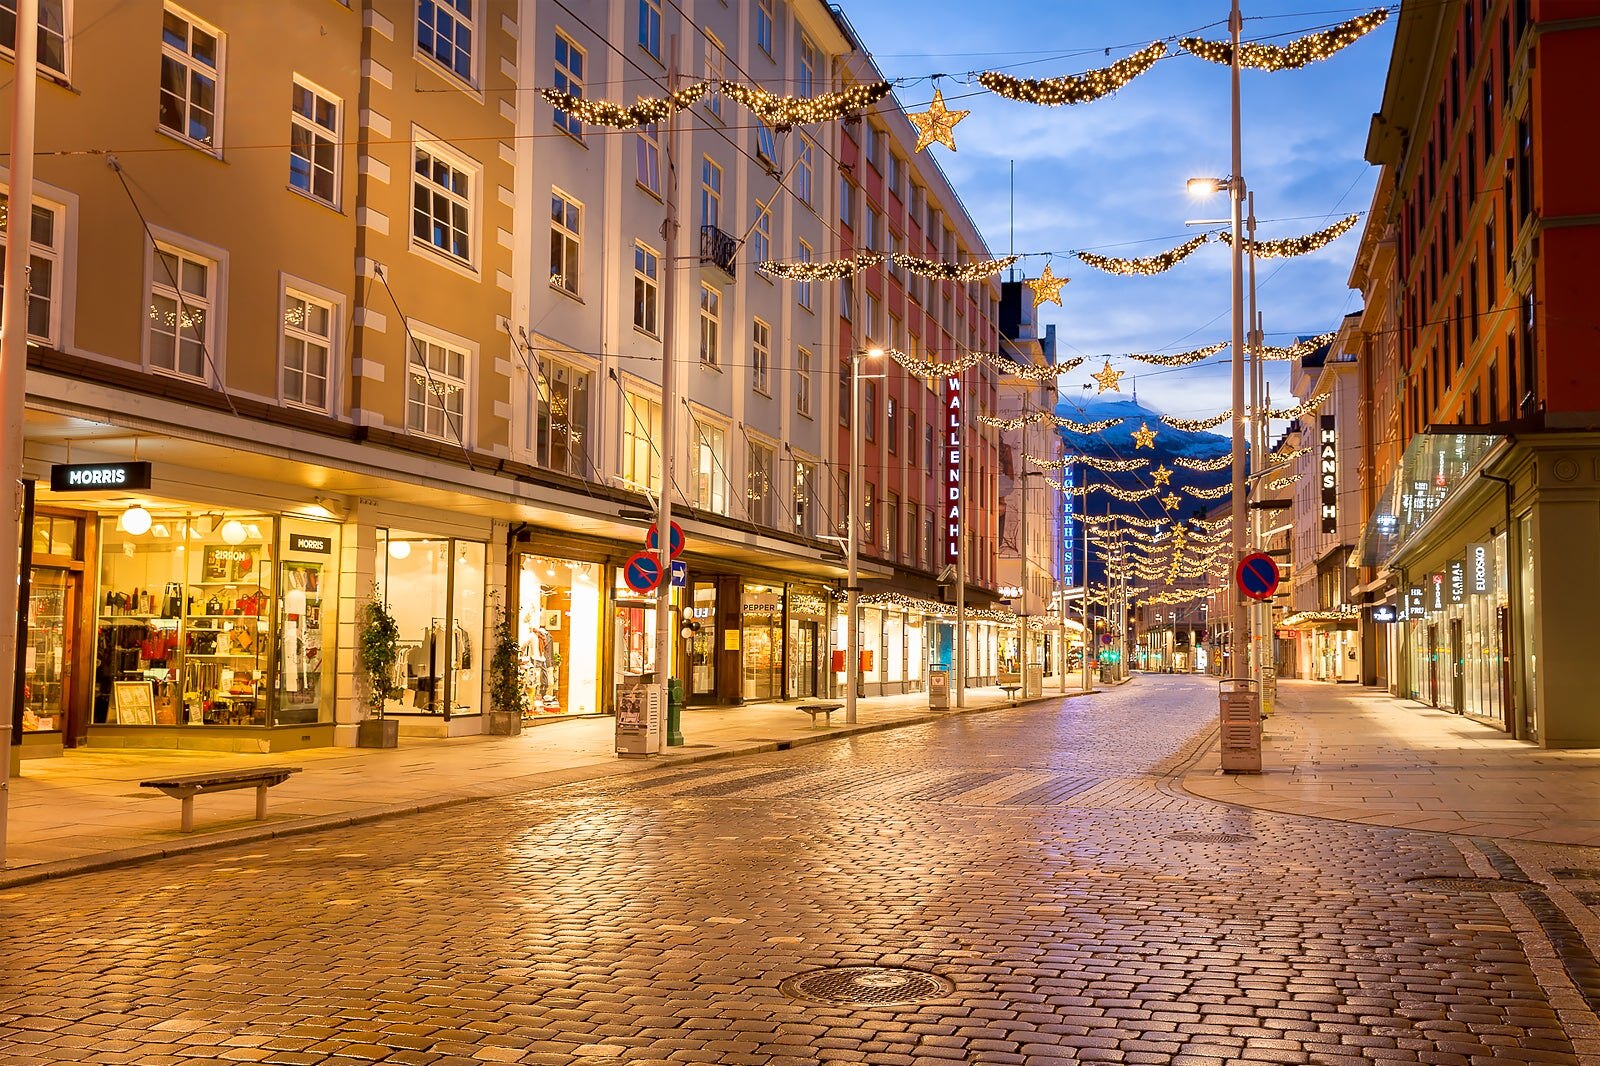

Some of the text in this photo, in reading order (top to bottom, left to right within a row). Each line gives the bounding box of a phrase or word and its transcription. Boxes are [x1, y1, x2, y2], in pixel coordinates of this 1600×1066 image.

[69, 469, 126, 485] MORRIS
[948, 378, 960, 555] WALLENDAHL
[1321, 430, 1335, 488] HANS
[297, 538, 324, 551] MORRIS
[1475, 546, 1486, 591] EUROSKO
